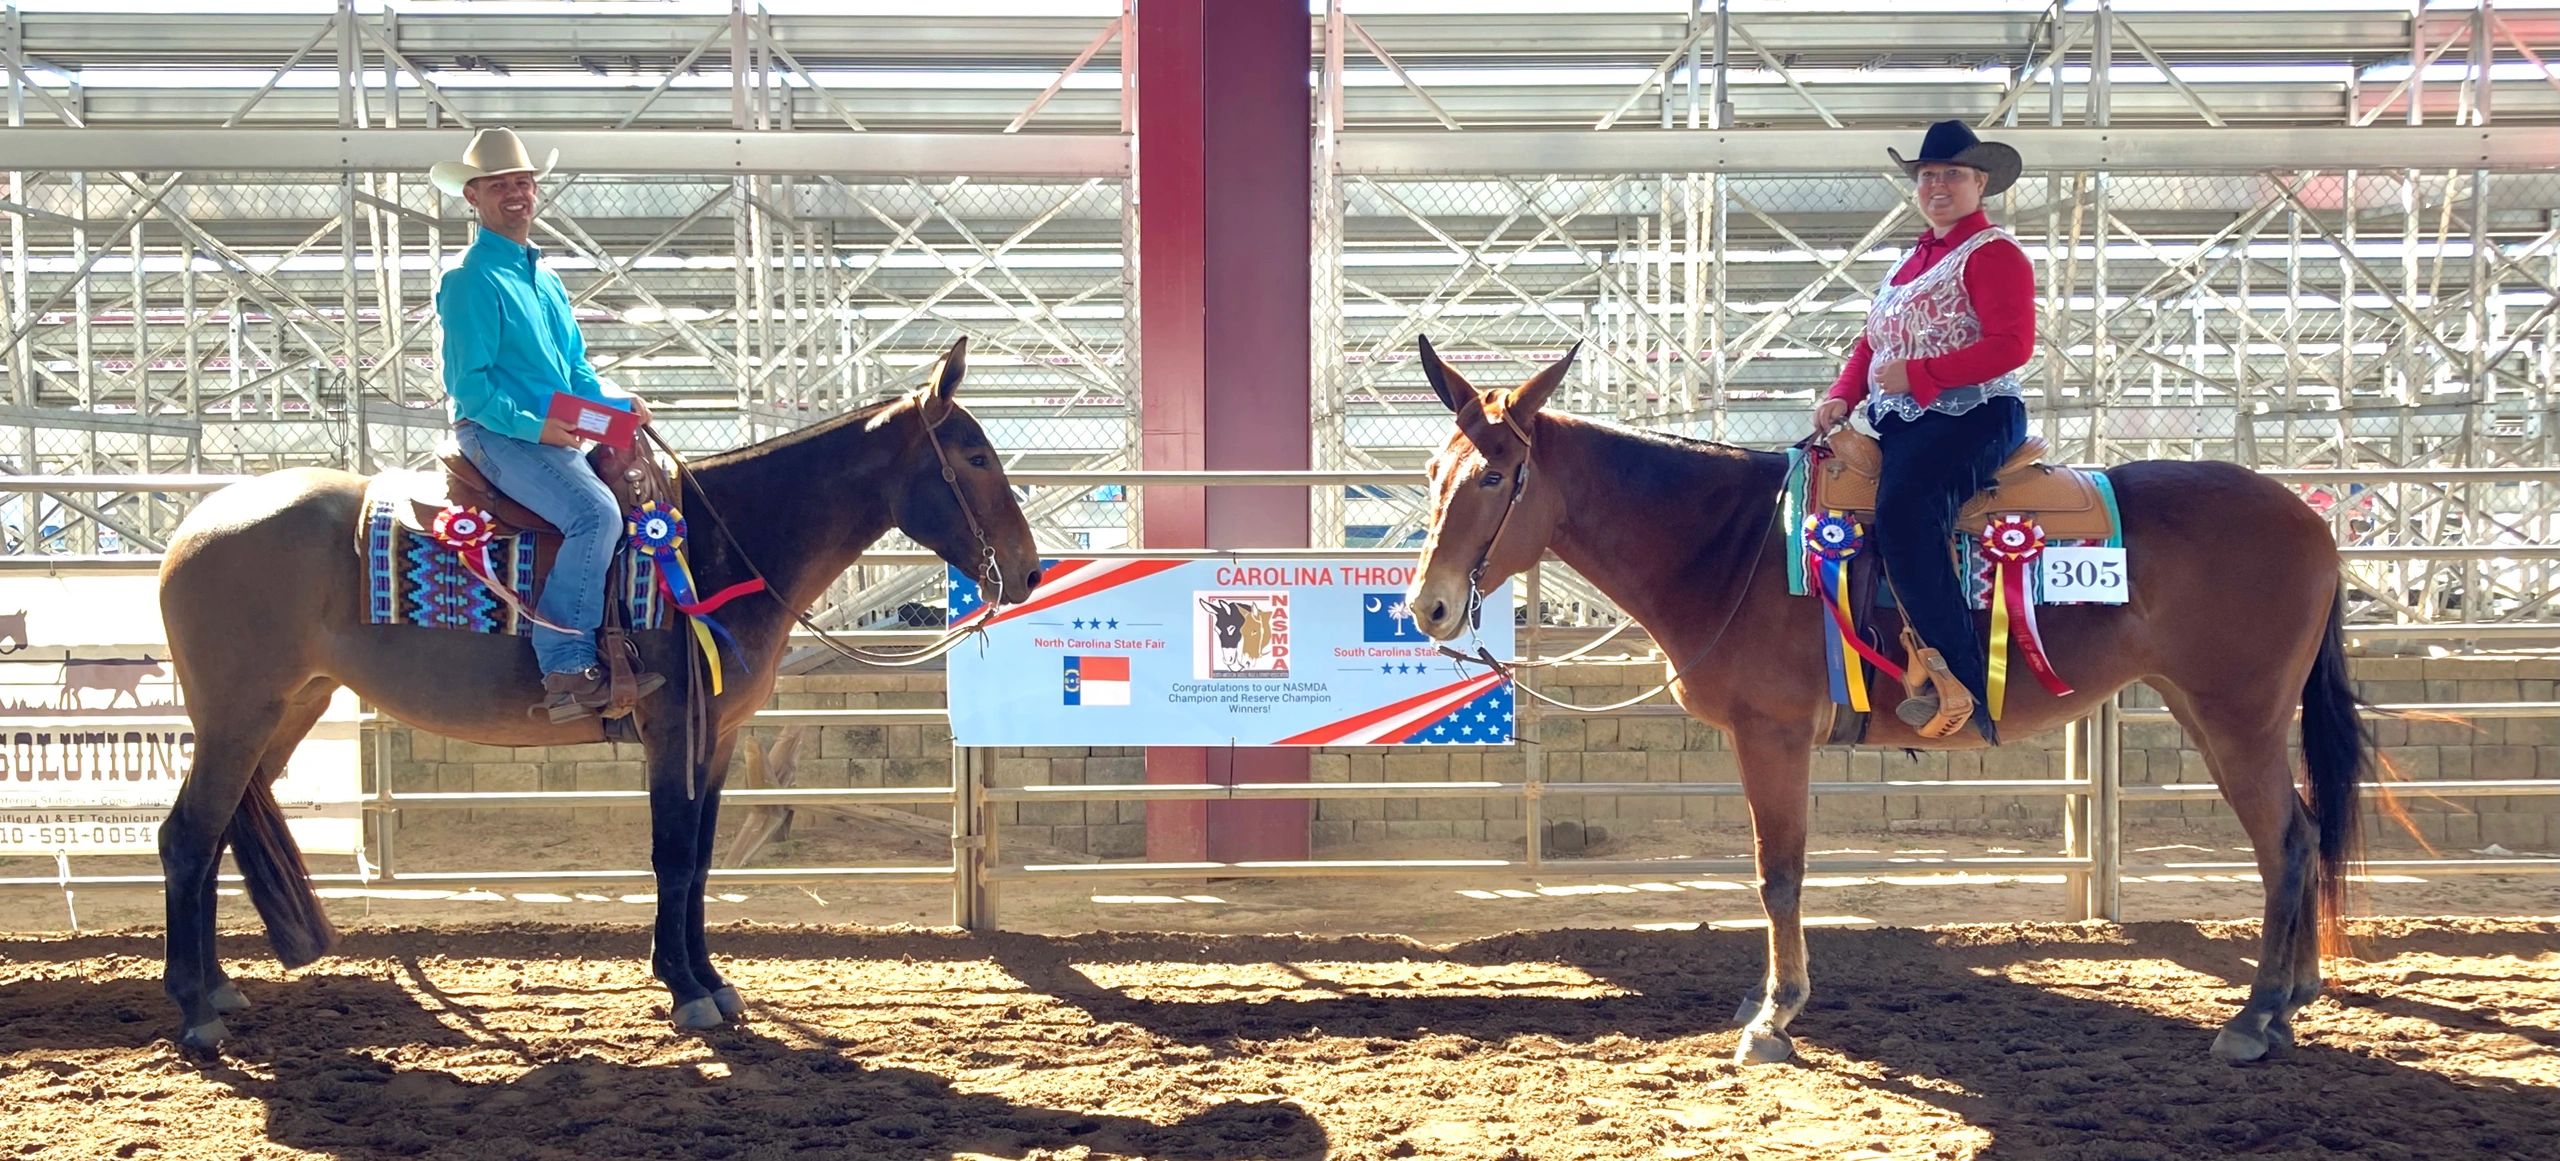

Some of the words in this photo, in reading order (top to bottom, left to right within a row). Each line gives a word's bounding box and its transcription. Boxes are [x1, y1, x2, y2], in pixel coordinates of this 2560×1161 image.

[1216, 567, 1333, 586] CAROLINA
[2050, 560, 2121, 588] 305
[1272, 595, 1288, 670] NASMDA
[1034, 638, 1064, 648] North
[1067, 638, 1111, 649] Carolina
[1114, 639, 1142, 649] State
[1145, 639, 1165, 649] Fair
[1334, 647, 1365, 657] South
[1368, 647, 1412, 657] Carolina
[1172, 683, 1250, 694] Congratulations
[1252, 683, 1262, 692] to
[1264, 684, 1281, 692] our
[1283, 683, 1327, 692] NASMDA
[1168, 694, 1217, 705] Champion
[1220, 694, 1238, 703] and
[1241, 694, 1280, 703] Reserve
[1282, 694, 1331, 705] Champion
[1229, 704, 1271, 713] Winners!
[41, 796, 86, 805] Statios
[55, 815, 63, 824] &
[69, 814, 84, 823] ET
[91, 814, 159, 823] Technician
